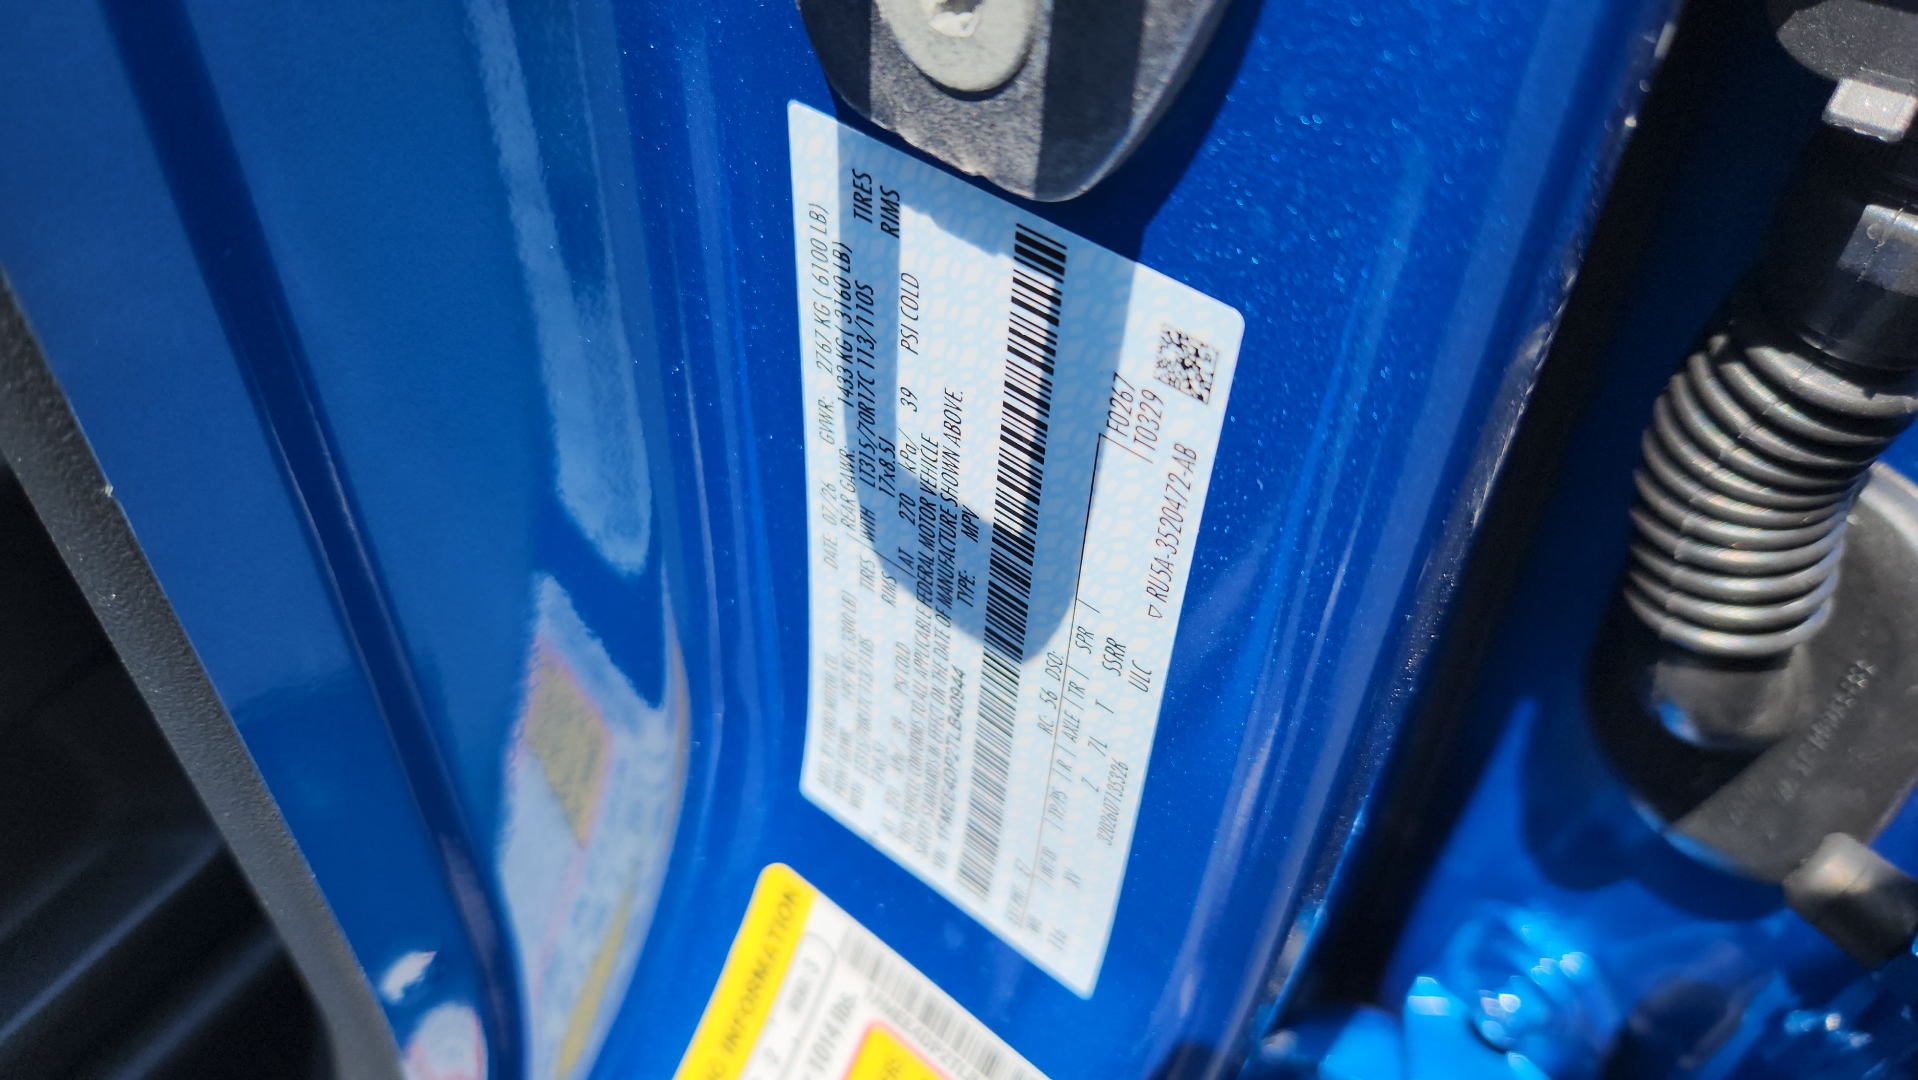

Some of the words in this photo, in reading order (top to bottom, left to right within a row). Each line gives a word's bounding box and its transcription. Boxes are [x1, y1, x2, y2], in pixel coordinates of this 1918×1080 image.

[851, 166, 872, 226] TIRES
[880, 184, 899, 239] RIMS
[808, 199, 828, 237] LB)
[831, 237, 852, 274] LB)
[813, 299, 831, 330] KG
[901, 269, 919, 323] COLD
[855, 278, 874, 370] 113/110S
[900, 318, 918, 354] PSI
[814, 328, 832, 375] 2767
[835, 335, 853, 364] KG
[836, 362, 853, 408] 1433
[900, 384, 917, 412] 39
[1106, 371, 1136, 437] F0267
[818, 393, 834, 446] GVWR:
[856, 369, 875, 488] LT315/70R17C
[942, 382, 963, 448] ABOVE.
[1133, 386, 1164, 453] T0329
[838, 441, 855, 495] GAWR:
[878, 435, 895, 499] 17x8.5J
[898, 427, 918, 475] kPa/
[919, 432, 938, 498] VEHICLE
[940, 445, 960, 508] SHOWN
[820, 477, 837, 527] 07/26
[840, 492, 855, 532] REAR
[899, 491, 915, 526] 270
[1145, 440, 1198, 603] RU5A-3520472-AB
[859, 504, 875, 544] WITH
[918, 494, 936, 552] MOTOR
[960, 504, 979, 542] MPV
[823, 529, 838, 570] DATE:
[898, 545, 914, 569] AT
[936, 504, 957, 609] MANUFACTURE
[859, 554, 875, 594] TIRES
[881, 570, 897, 608] RIMS
[916, 548, 934, 609] FEDERAL
[957, 566, 975, 609] TYPE:
[841, 587, 857, 614] LB)
[936, 605, 951, 629] OF
[894, 638, 910, 675] COLD
[912, 605, 931, 680] APPLICABLE
[934, 625, 950, 662] DATE
[1075, 623, 1094, 655] SPR
[1101, 634, 1126, 677] SSRR
[840, 650, 855, 674] KG
[932, 658, 948, 686] THE
[1044, 647, 1064, 681] DSO:
[1127, 658, 1152, 694] ULC
[824, 667, 837, 713] MOTOR
[894, 671, 909, 696] PSI
[911, 675, 927, 703] ALL
[930, 683, 946, 706] ON
[1039, 685, 1058, 710] 56
[1067, 679, 1085, 701] TR
[823, 708, 836, 743] FORD
[891, 713, 906, 736] 39
[910, 697, 926, 719] TO
[928, 702, 944, 744] EFFECT
[1037, 711, 1054, 735] RC:
[1060, 709, 1080, 743] AXLE
[1095, 698, 1114, 716] T
[906, 714, 924, 778] CONFORMS
[927, 740, 941, 760] IN
[1056, 757, 1072, 772] R
[902, 773, 920, 821] VEHICLE
[921, 754, 940, 821] STANDARDS
[1048, 784, 1068, 822] TP/PS
[1096, 755, 1128, 847] 3202607135326
[1037, 856, 1055, 879] INT
[1040, 843, 1057, 862] TR
[721, 883, 799, 1055] INFORMATION
